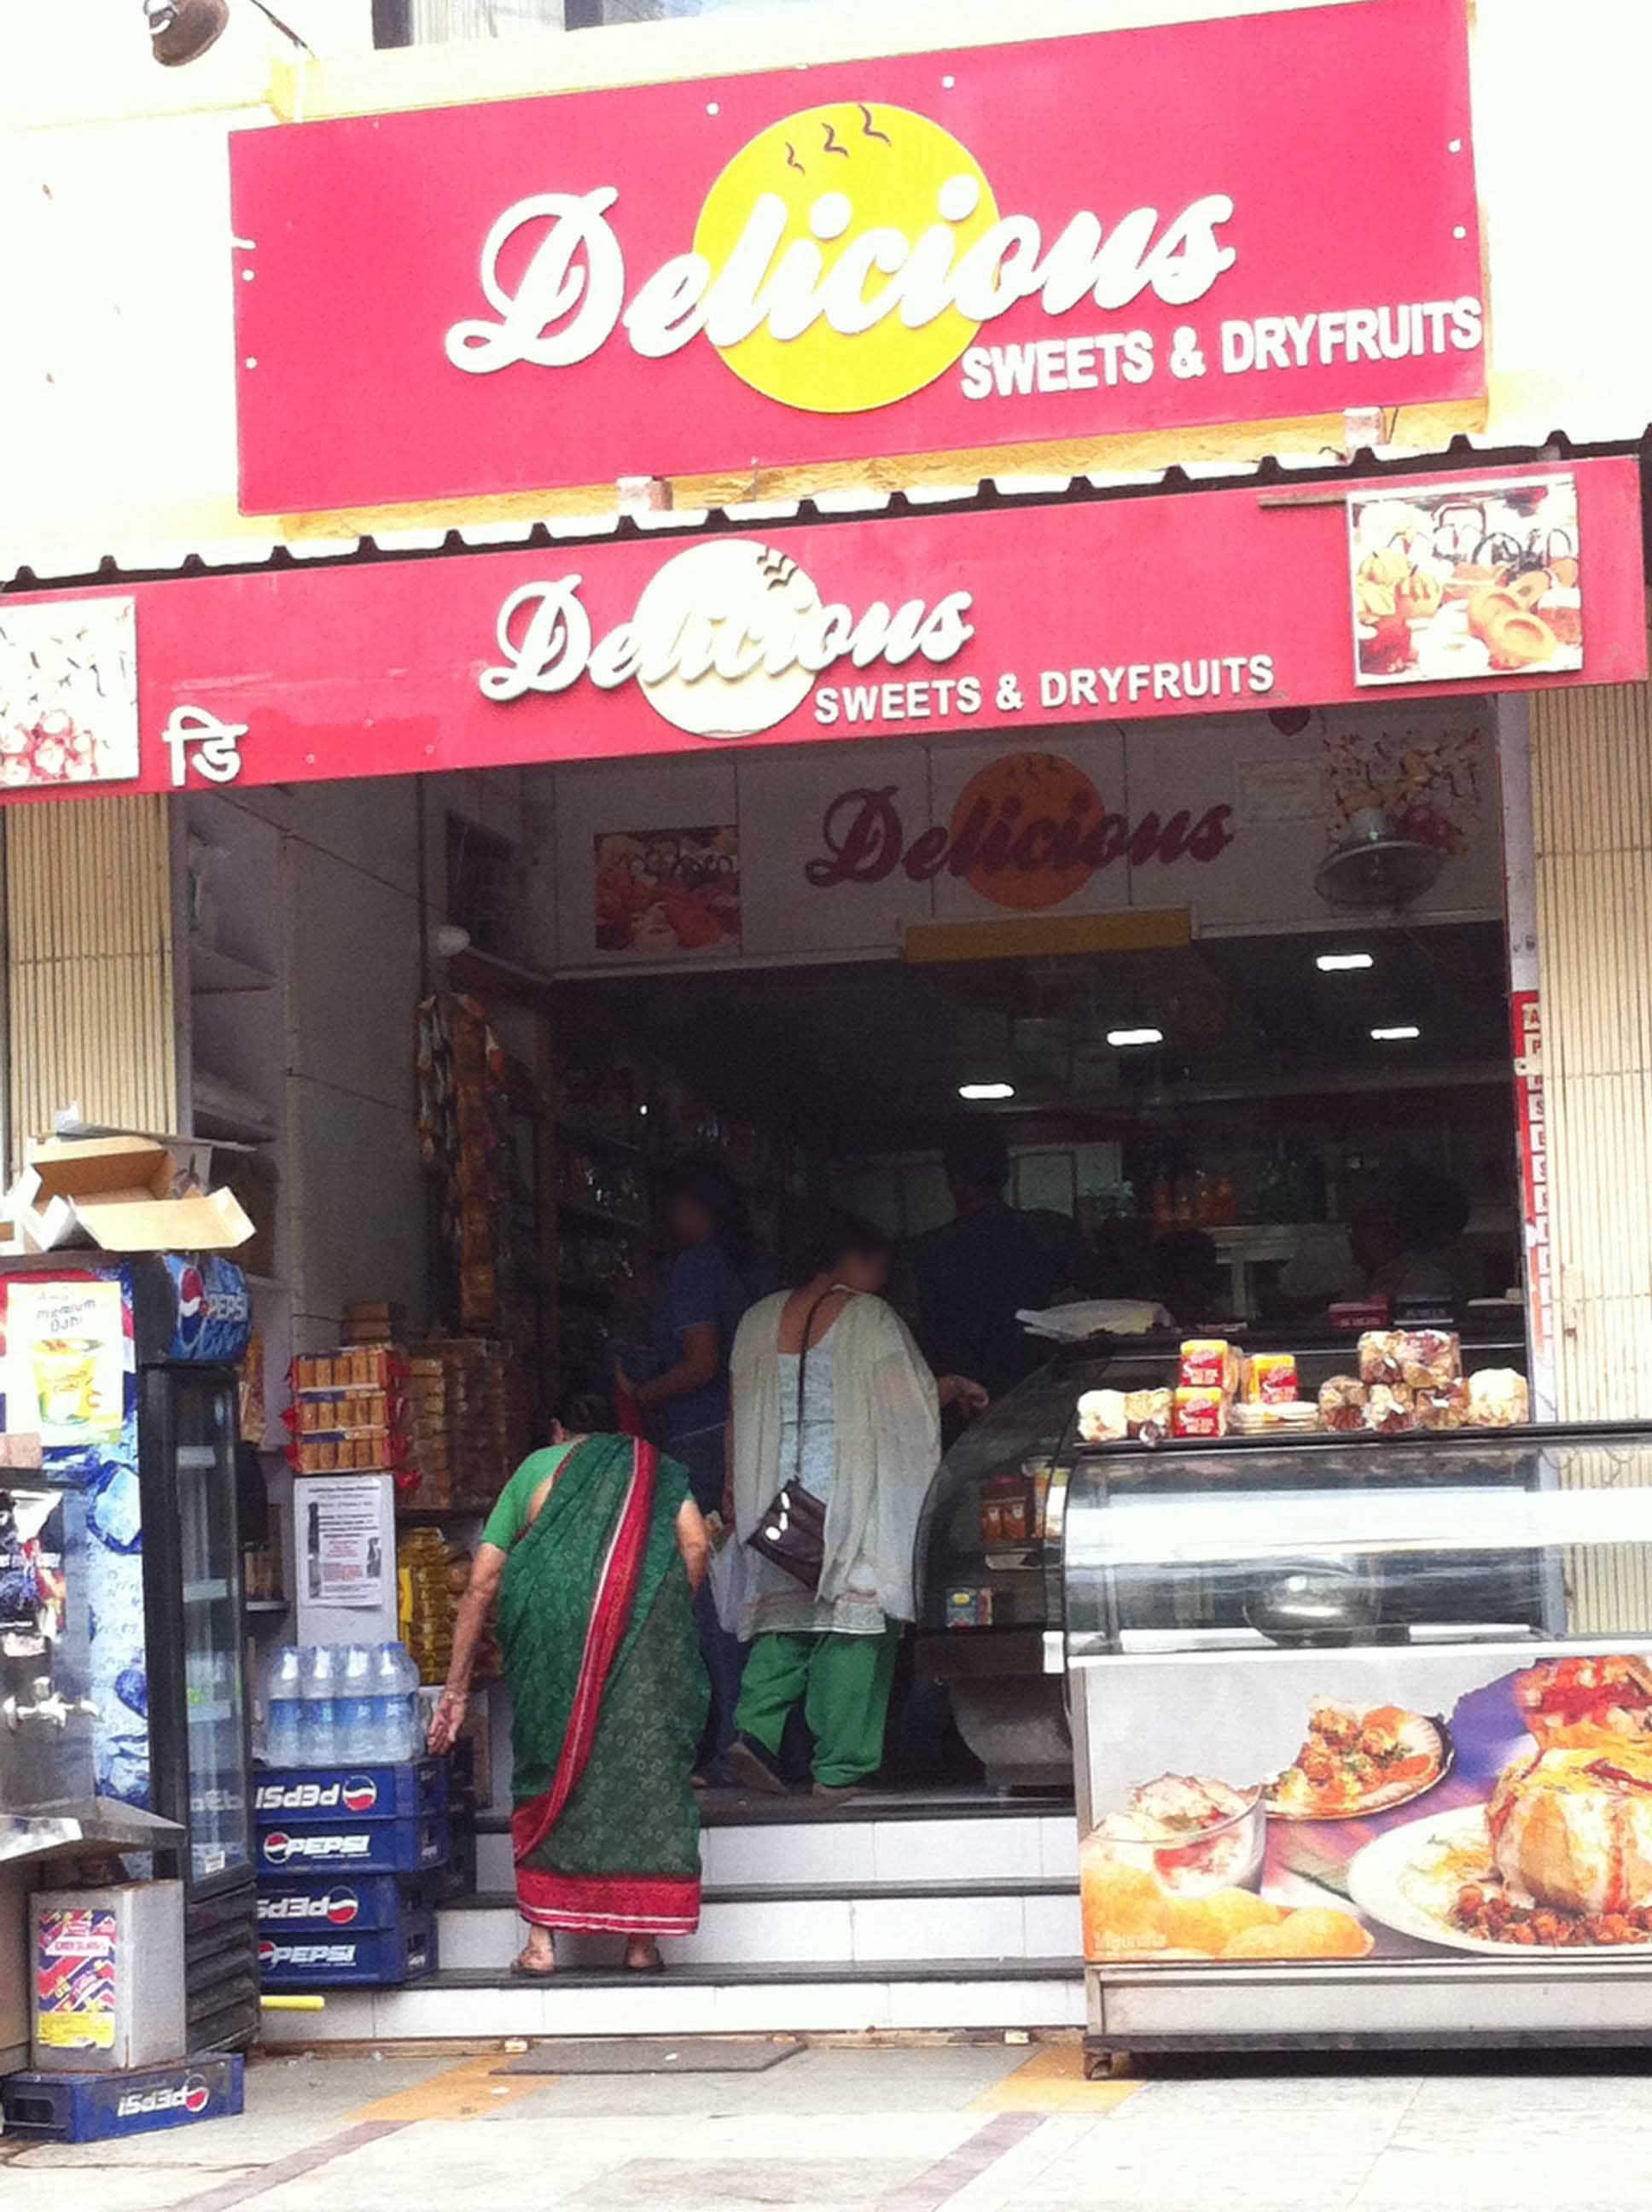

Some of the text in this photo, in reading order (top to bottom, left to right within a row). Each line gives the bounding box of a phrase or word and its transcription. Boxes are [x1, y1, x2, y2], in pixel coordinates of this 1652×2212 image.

[445, 174, 1236, 375] Delicious
[960, 296, 1482, 399] SWEETS & DRYFRUITS
[479, 573, 974, 701] Delicious
[814, 654, 1275, 725] SWEETS & DRYFRUITS
[804, 783, 1235, 888] Delicious
[256, 1783, 340, 1809] PEPSI
[285, 1835, 371, 1856] PEPSI
[256, 1896, 330, 1919] PEPS
[272, 1945, 357, 1964] PEPSI
[117, 2085, 189, 2117] PEPSI
